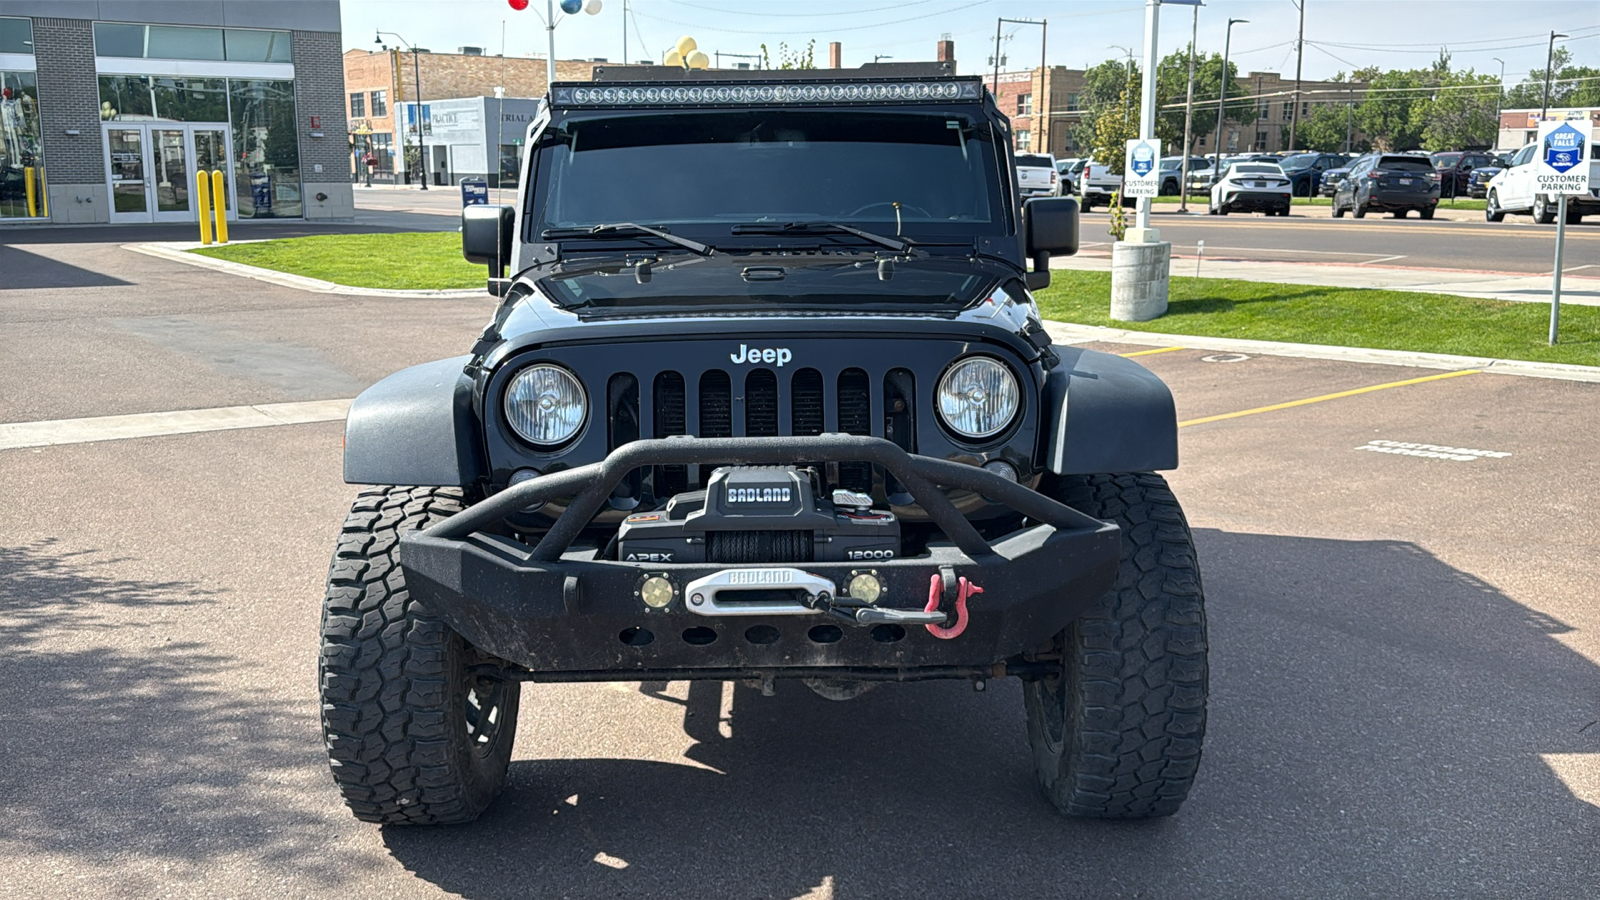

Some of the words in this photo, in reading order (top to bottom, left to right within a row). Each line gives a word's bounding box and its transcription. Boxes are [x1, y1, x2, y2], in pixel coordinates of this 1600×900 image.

[1537, 175, 1587, 183] CUSTOMER
[1541, 183, 1581, 191] PARKING
[730, 343, 792, 367] Jeep
[728, 487, 791, 503] BADLAND
[626, 552, 673, 563] APEX
[847, 549, 894, 560] 12000
[728, 570, 793, 584] BADLAND
